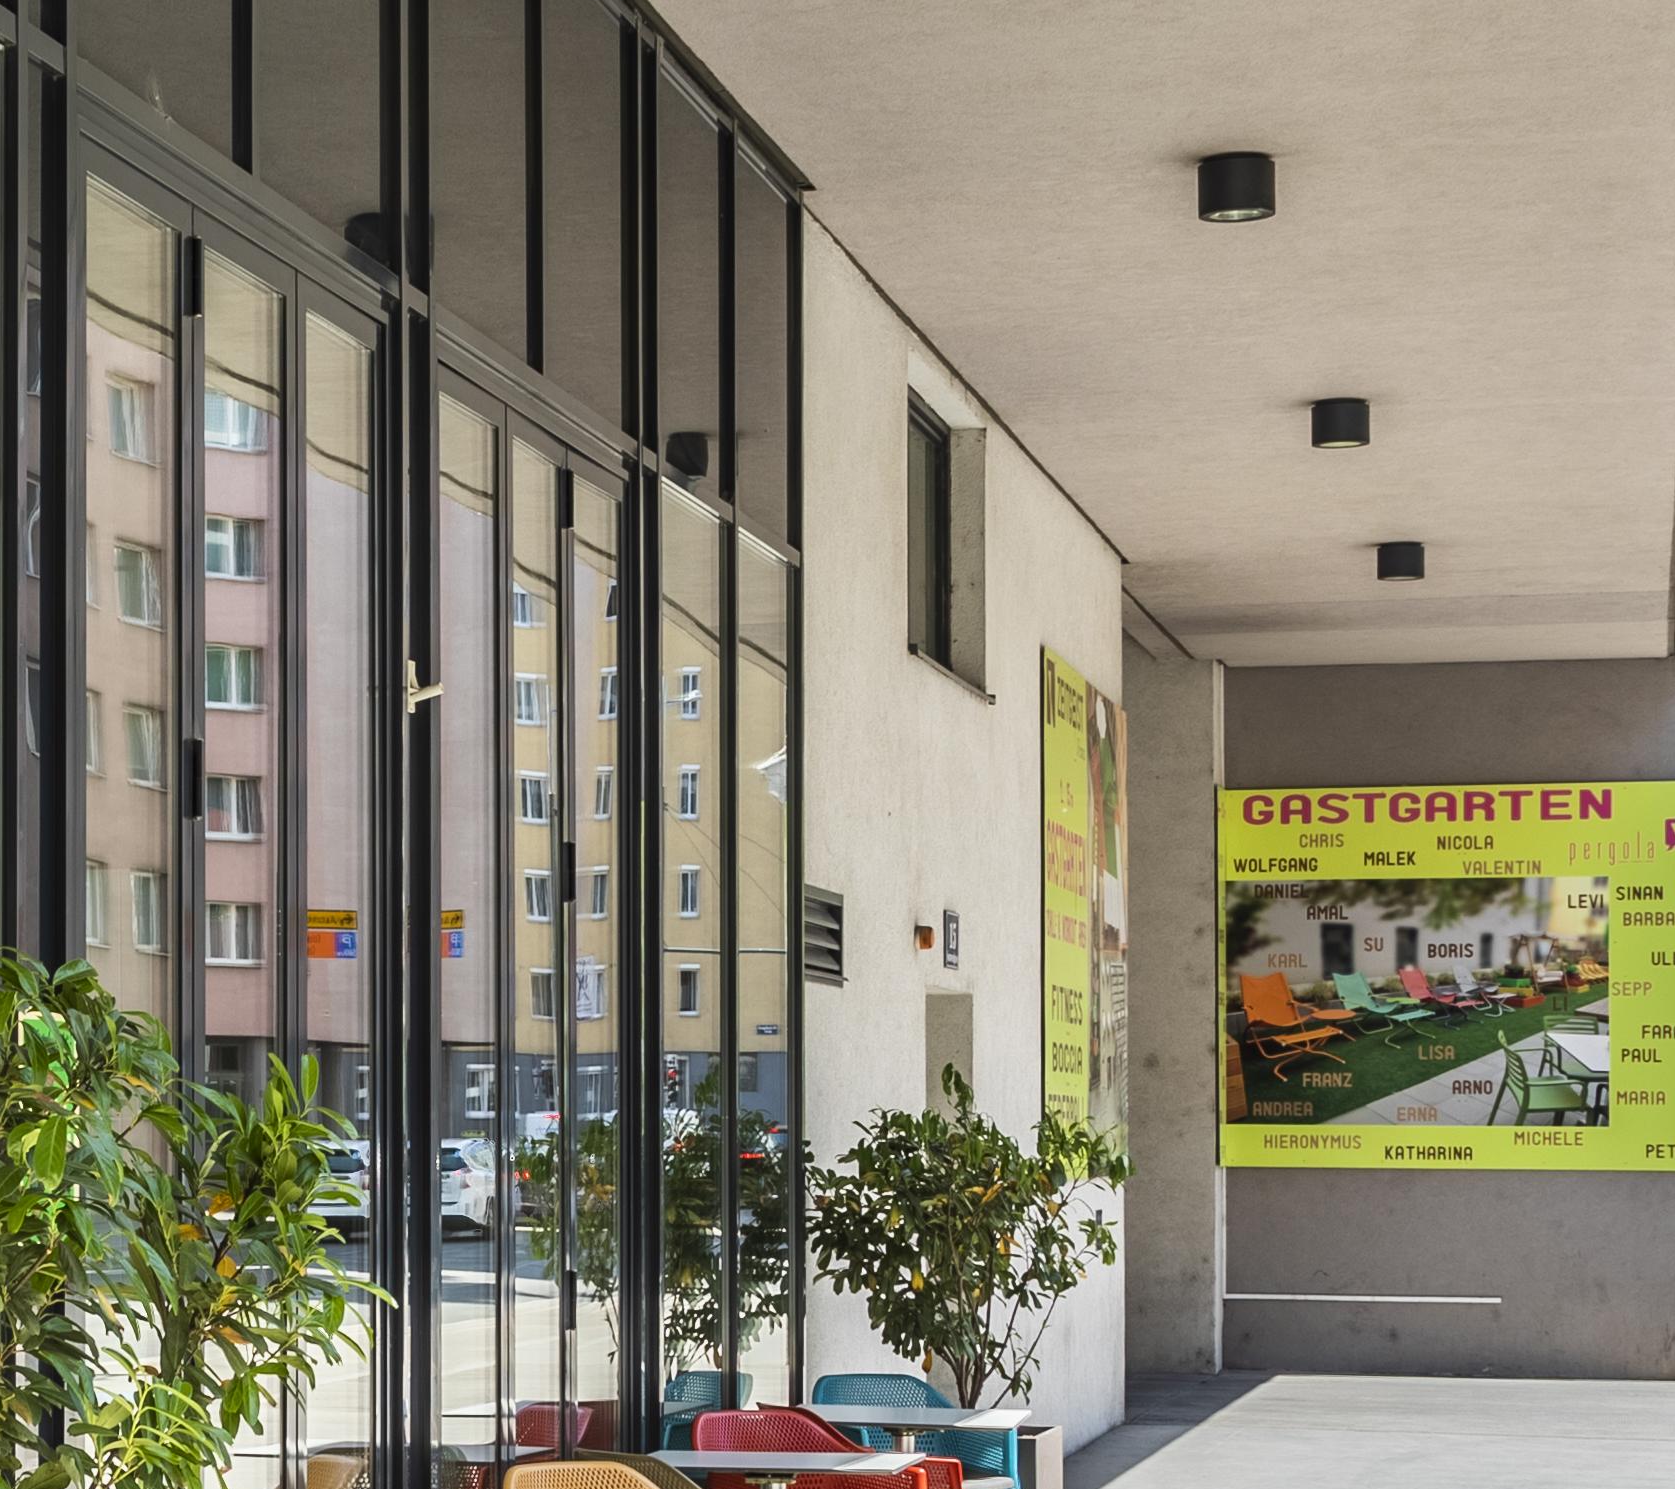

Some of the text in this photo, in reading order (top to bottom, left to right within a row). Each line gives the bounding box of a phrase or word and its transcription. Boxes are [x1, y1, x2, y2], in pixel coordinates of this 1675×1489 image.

[1241, 788, 1614, 827] GASTGARTEN
[1299, 833, 1345, 849] CHRIS
[1436, 835, 1495, 851] NICOLA
[1568, 831, 1656, 866] pergola
[1233, 857, 1319, 874] WOLFGANG
[1363, 850, 1417, 867] MALEK
[1461, 860, 1542, 876] VALENTIN
[1254, 883, 1310, 899] DANIEL
[1615, 885, 1664, 901] SINAN
[1567, 893, 1605, 909] LEVI
[1306, 905, 1349, 921] AMAL
[1363, 937, 1384, 952] SU
[1427, 943, 1475, 959] BORIS
[1267, 953, 1308, 969] KARL
[1611, 981, 1653, 997] SEPP
[1052, 984, 1083, 1027] FITNESS
[1553, 996, 1568, 1011] LI
[1052, 1041, 1083, 1076] BOCCIA
[1418, 1045, 1456, 1061] LISA
[1621, 1048, 1663, 1063] PAUL
[1302, 1072, 1353, 1088] FRANZ
[1452, 1079, 1494, 1095] ARNO
[1616, 1090, 1666, 1106] MARIA
[1252, 1101, 1314, 1117] ANDREA
[1396, 1106, 1438, 1122] ERNA
[1263, 1133, 1362, 1150] HIERONYMUS
[1513, 1130, 1584, 1146] MICHELE
[1384, 1145, 1474, 1161] KATHARINA
